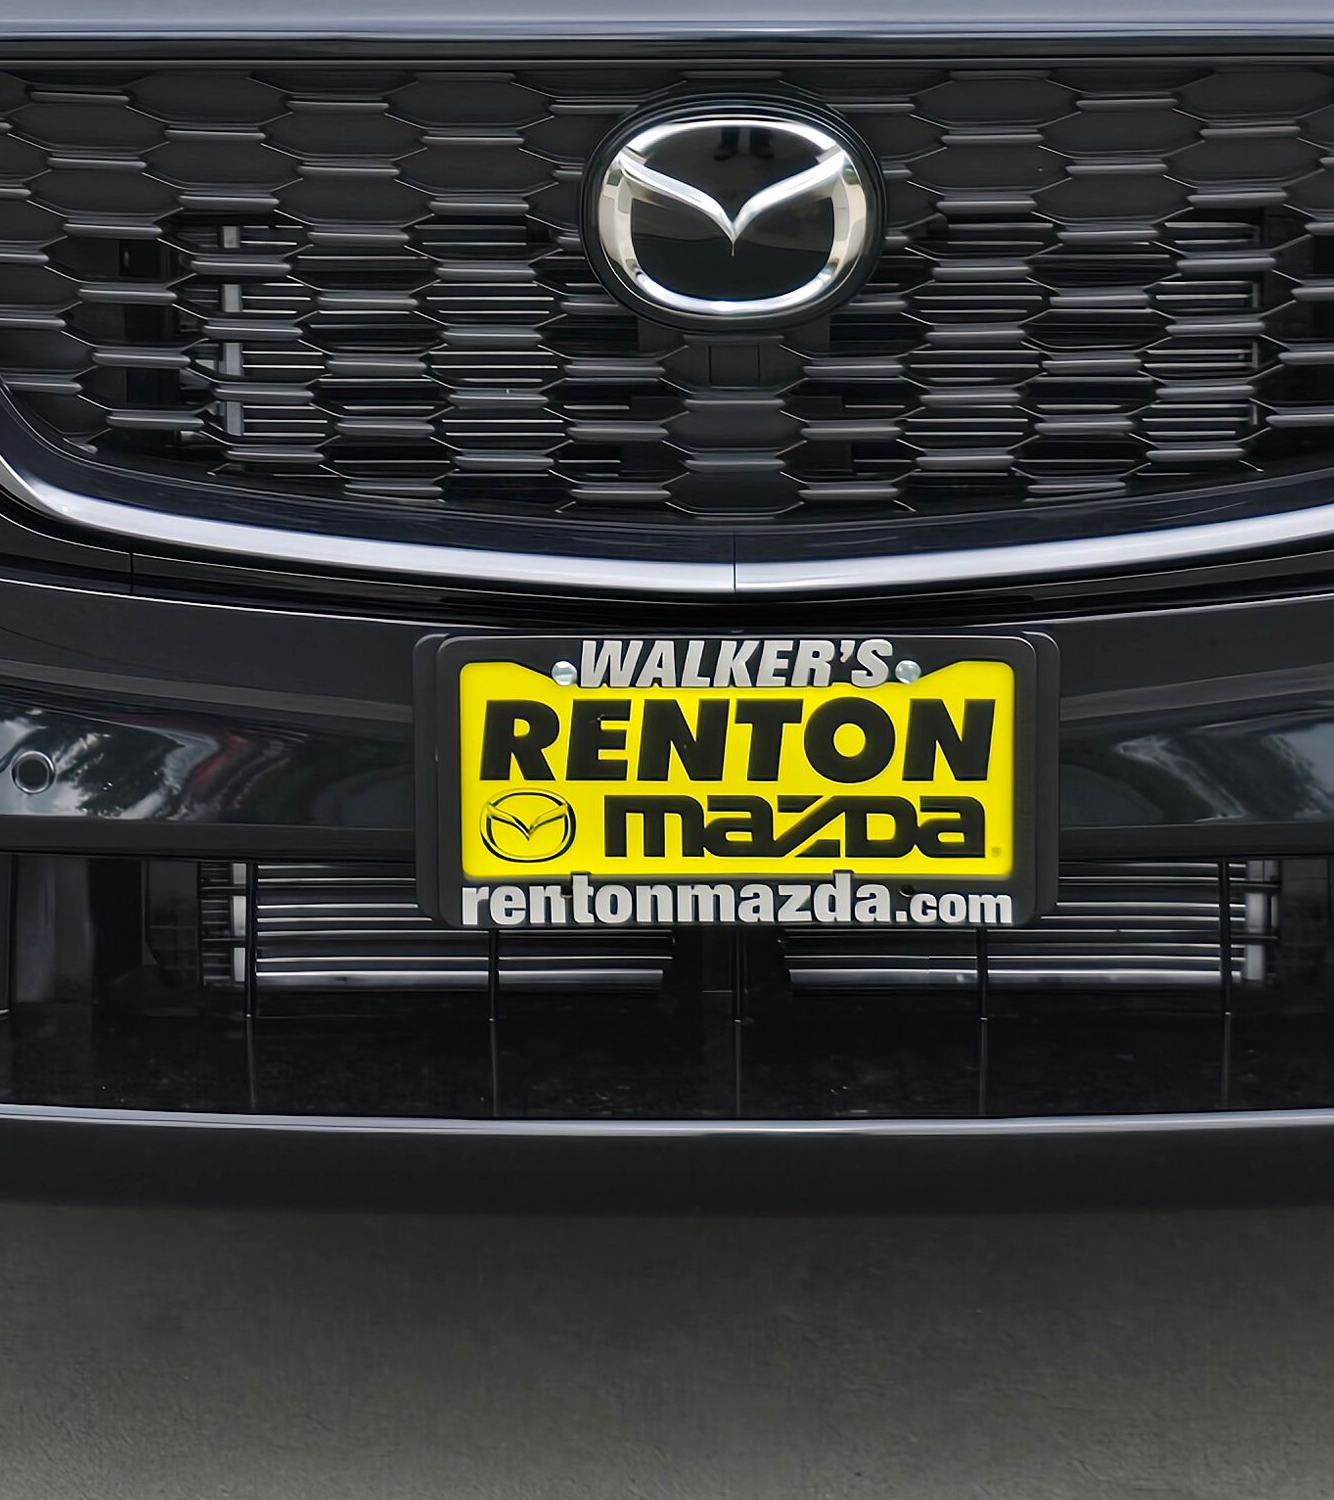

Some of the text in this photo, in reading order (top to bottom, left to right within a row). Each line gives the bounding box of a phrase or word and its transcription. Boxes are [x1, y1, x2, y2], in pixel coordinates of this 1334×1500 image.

[580, 638, 894, 689] WALKER'S
[479, 697, 996, 784] RENTON
[461, 870, 1014, 926] rentonmazda.com
